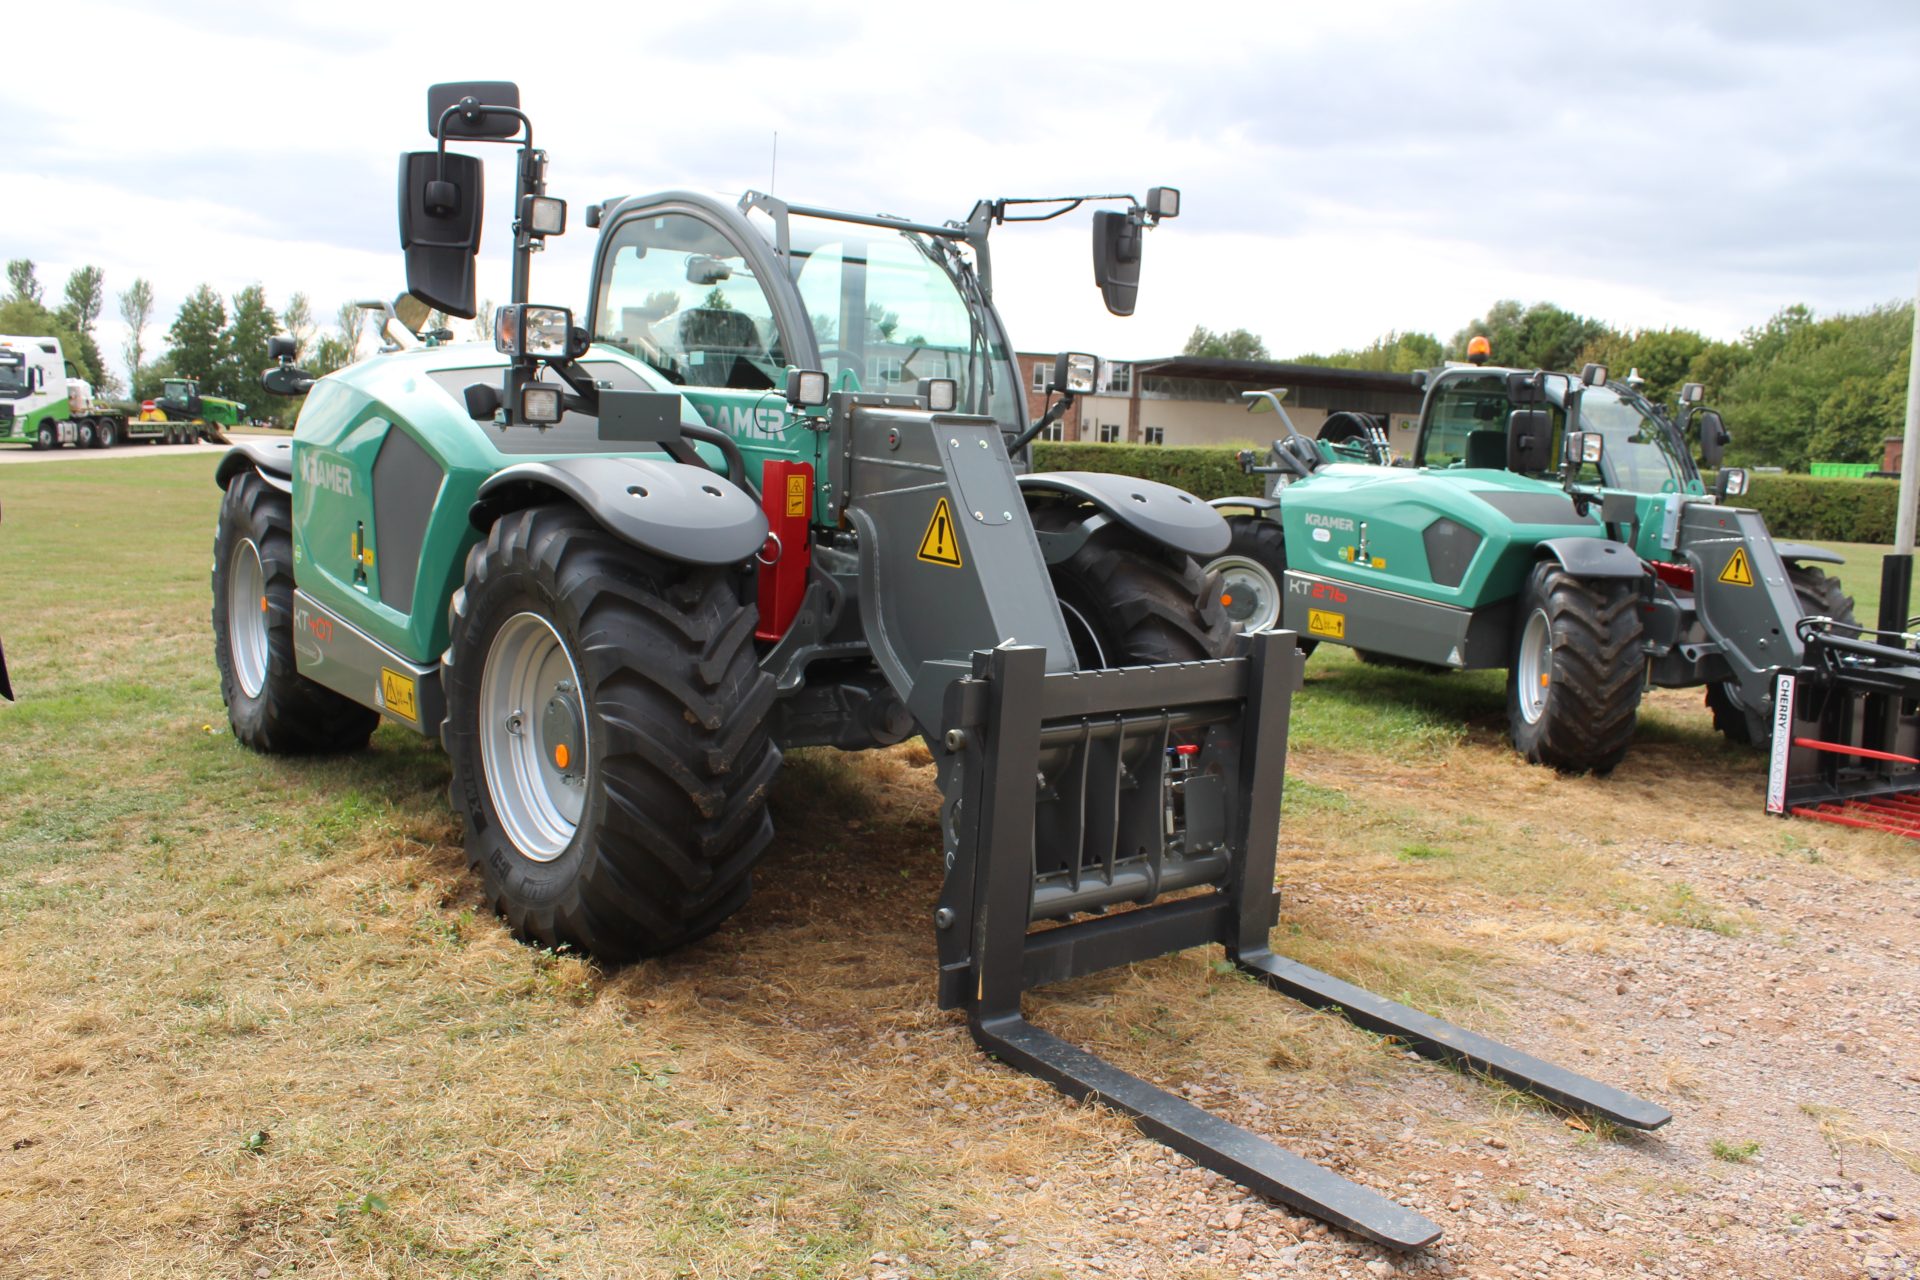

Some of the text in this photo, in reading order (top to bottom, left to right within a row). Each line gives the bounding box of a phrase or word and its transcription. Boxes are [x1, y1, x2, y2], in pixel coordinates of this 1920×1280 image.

[696, 403, 786, 442] RAMER
[299, 448, 354, 497] KRAMER
[1305, 512, 1354, 532] KRAMER
[1289, 579, 1348, 603] KT276
